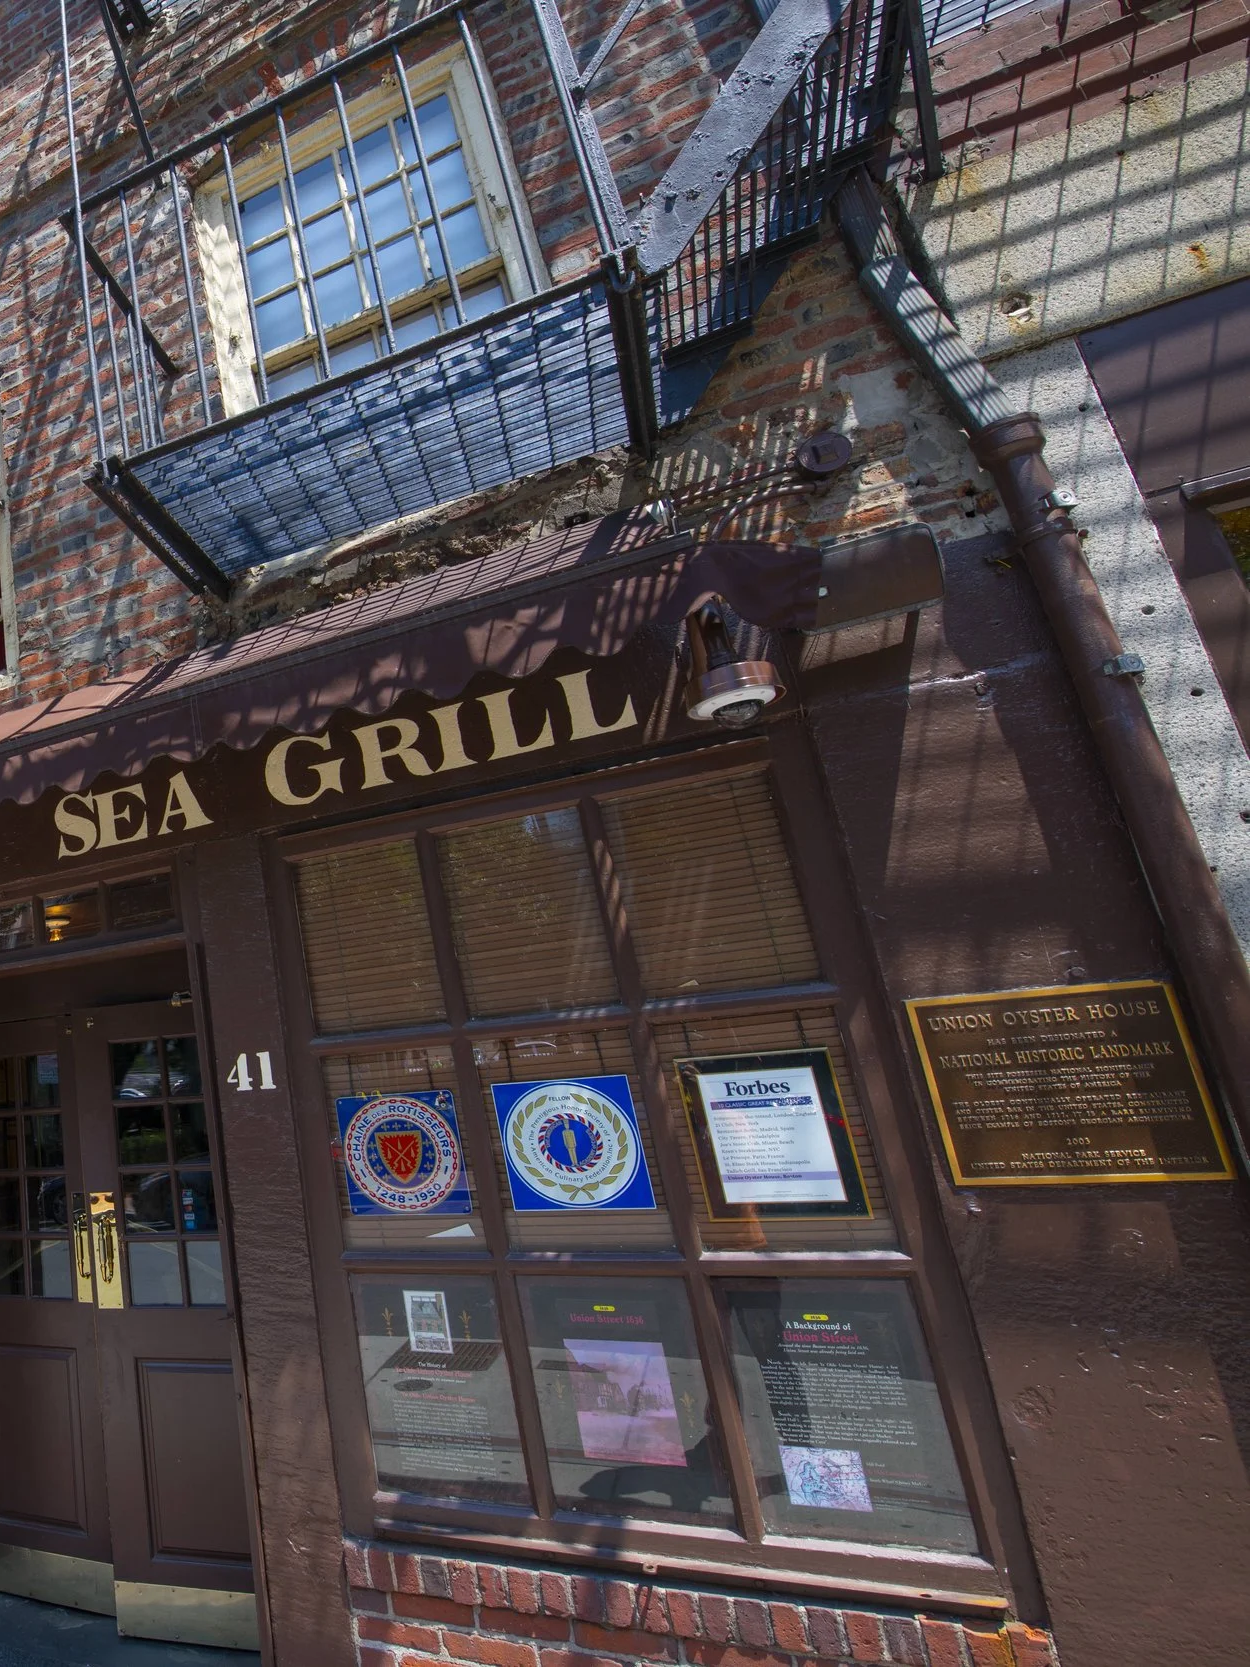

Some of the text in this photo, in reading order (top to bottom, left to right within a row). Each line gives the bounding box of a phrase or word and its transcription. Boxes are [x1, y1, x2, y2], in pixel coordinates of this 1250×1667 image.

[53, 668, 639, 860] SEA GRILL
[928, 1001, 1161, 1031] UNION OYSTER HOUSE
[987, 1037, 1006, 1045] HAS
[1010, 1035, 1036, 1044] BEEN
[1040, 1030, 1106, 1042] DESIGNATED
[939, 1041, 1174, 1068] NATIONAL HISTORIC LANDMARK
[227, 1051, 277, 1092] 41
[1050, 1066, 1092, 1075] NATIONAL
[1095, 1063, 1155, 1072] SIGNIFICANCE
[986, 1076, 1058, 1086] COMMEMORATING
[1060, 1074, 1079, 1082] THE
[1080, 1072, 1115, 1080] HISTORY
[1133, 1070, 1151, 1078] THE
[1070, 1081, 1081, 1089] OF
[1084, 1080, 1122, 1088] AMERICA
[724, 1080, 791, 1097] Forbes
[725, 1100, 747, 1108] CLASSIC
[748, 1099, 765, 1107] GREAT
[973, 1099, 1005, 1107] OLDEST
[1075, 1093, 1122, 1102] OPERATED
[1126, 1090, 1186, 1100] RESTAURANT
[1128, 1099, 1190, 1107] CONSTRUCTED
[1139, 1105, 1192, 1114] SURVIVING
[531, 1105, 560, 1130] Prestigious
[583, 1108, 606, 1130] Society
[604, 1129, 611, 1137] of
[985, 1121, 1020, 1129] EXAMPLE
[1080, 1116, 1123, 1124] GEORGIAN
[352, 1105, 451, 1161] CHAINE DES ROTISSEURS
[1066, 1137, 1091, 1146] 2003
[1021, 1149, 1147, 1160] NATIONAL PARK SERVICE
[531, 1147, 553, 1174] American
[554, 1171, 584, 1183] Culinary
[970, 1156, 1209, 1169] UNITED STATES DEPARTMENT OF THE INTERIOR
[570, 1313, 644, 1325] Union Street 1636
[785, 1321, 851, 1331] A Background of
[783, 1331, 859, 1344] Union Street
